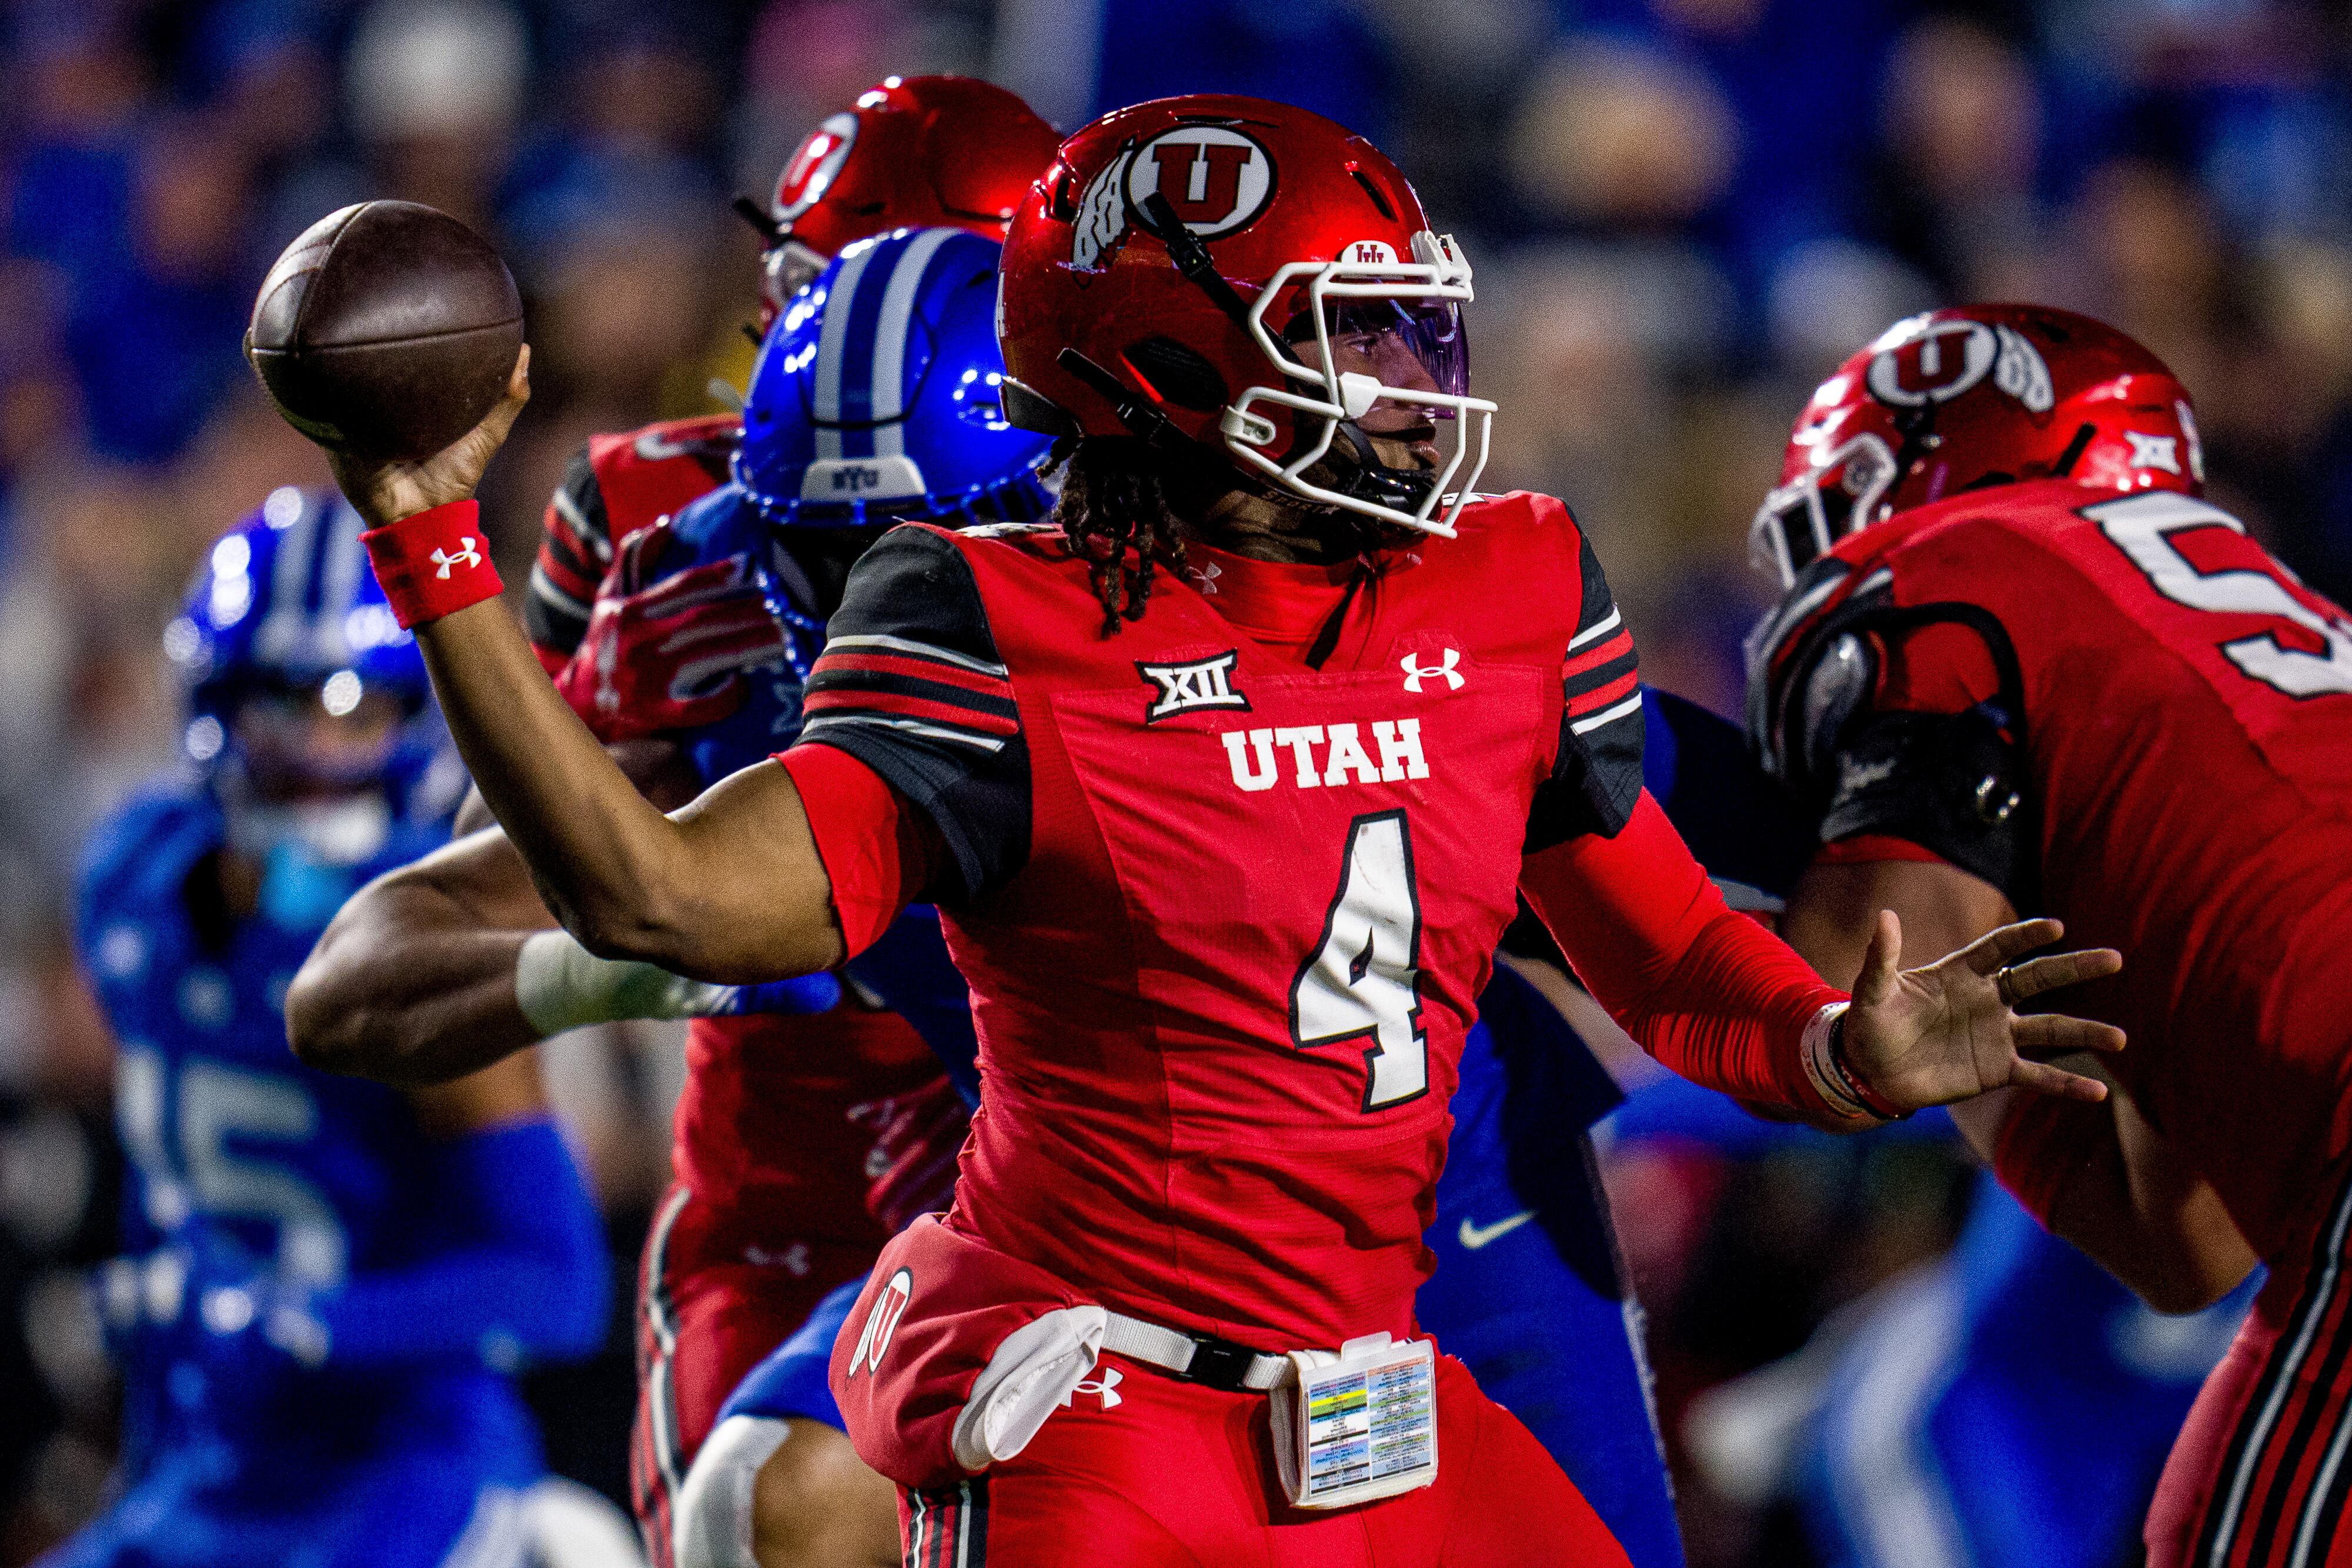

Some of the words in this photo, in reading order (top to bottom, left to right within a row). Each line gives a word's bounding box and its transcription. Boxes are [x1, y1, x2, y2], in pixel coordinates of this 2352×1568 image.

[1151, 143, 1252, 224] U
[1886, 329, 1970, 390] U
[1143, 654, 1248, 716] XII
[1221, 717, 1430, 793] UTAH
[1288, 807, 1430, 1114] 4
